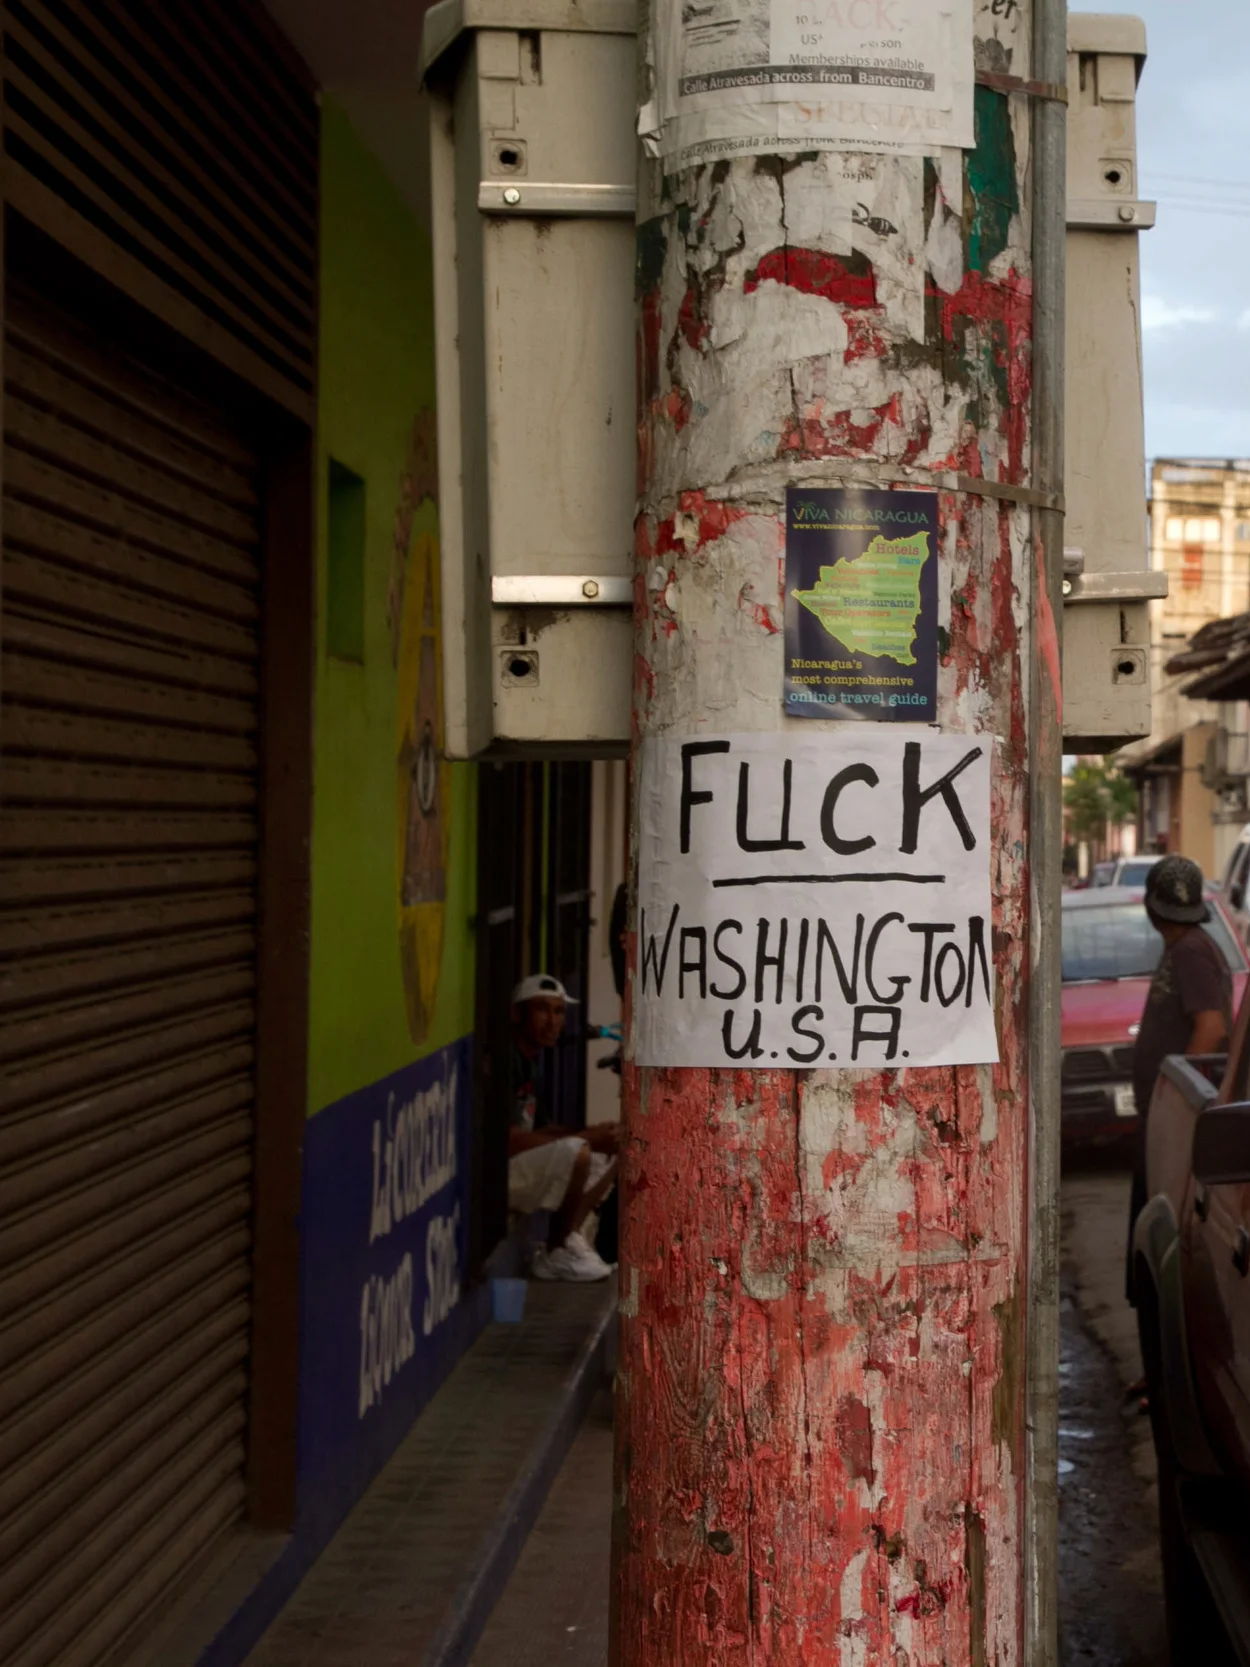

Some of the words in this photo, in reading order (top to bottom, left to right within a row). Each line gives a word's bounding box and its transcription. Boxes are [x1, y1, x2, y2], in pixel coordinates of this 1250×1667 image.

[788, 53, 871, 67] Memberships
[873, 57, 925, 71] available
[684, 79, 708, 95] Calle
[709, 72, 769, 90] Atravesada
[771, 70, 813, 83] across
[819, 70, 852, 83] from
[858, 72, 925, 89] Bancentro
[792, 507, 830, 521] VIVA
[835, 508, 929, 524] NICARAGUA
[875, 543, 920, 556] Hotels
[843, 597, 915, 609] Restaurants
[791, 658, 862, 671] Nicaragua's
[791, 675, 821, 685] most
[824, 676, 914, 687] comprehensive
[790, 691, 837, 705] online
[840, 691, 884, 705] travel
[888, 692, 928, 707] guide
[680, 739, 983, 856] FUCK
[641, 903, 991, 1008] WASHINGTON
[721, 1004, 910, 1063] U.S.A.
